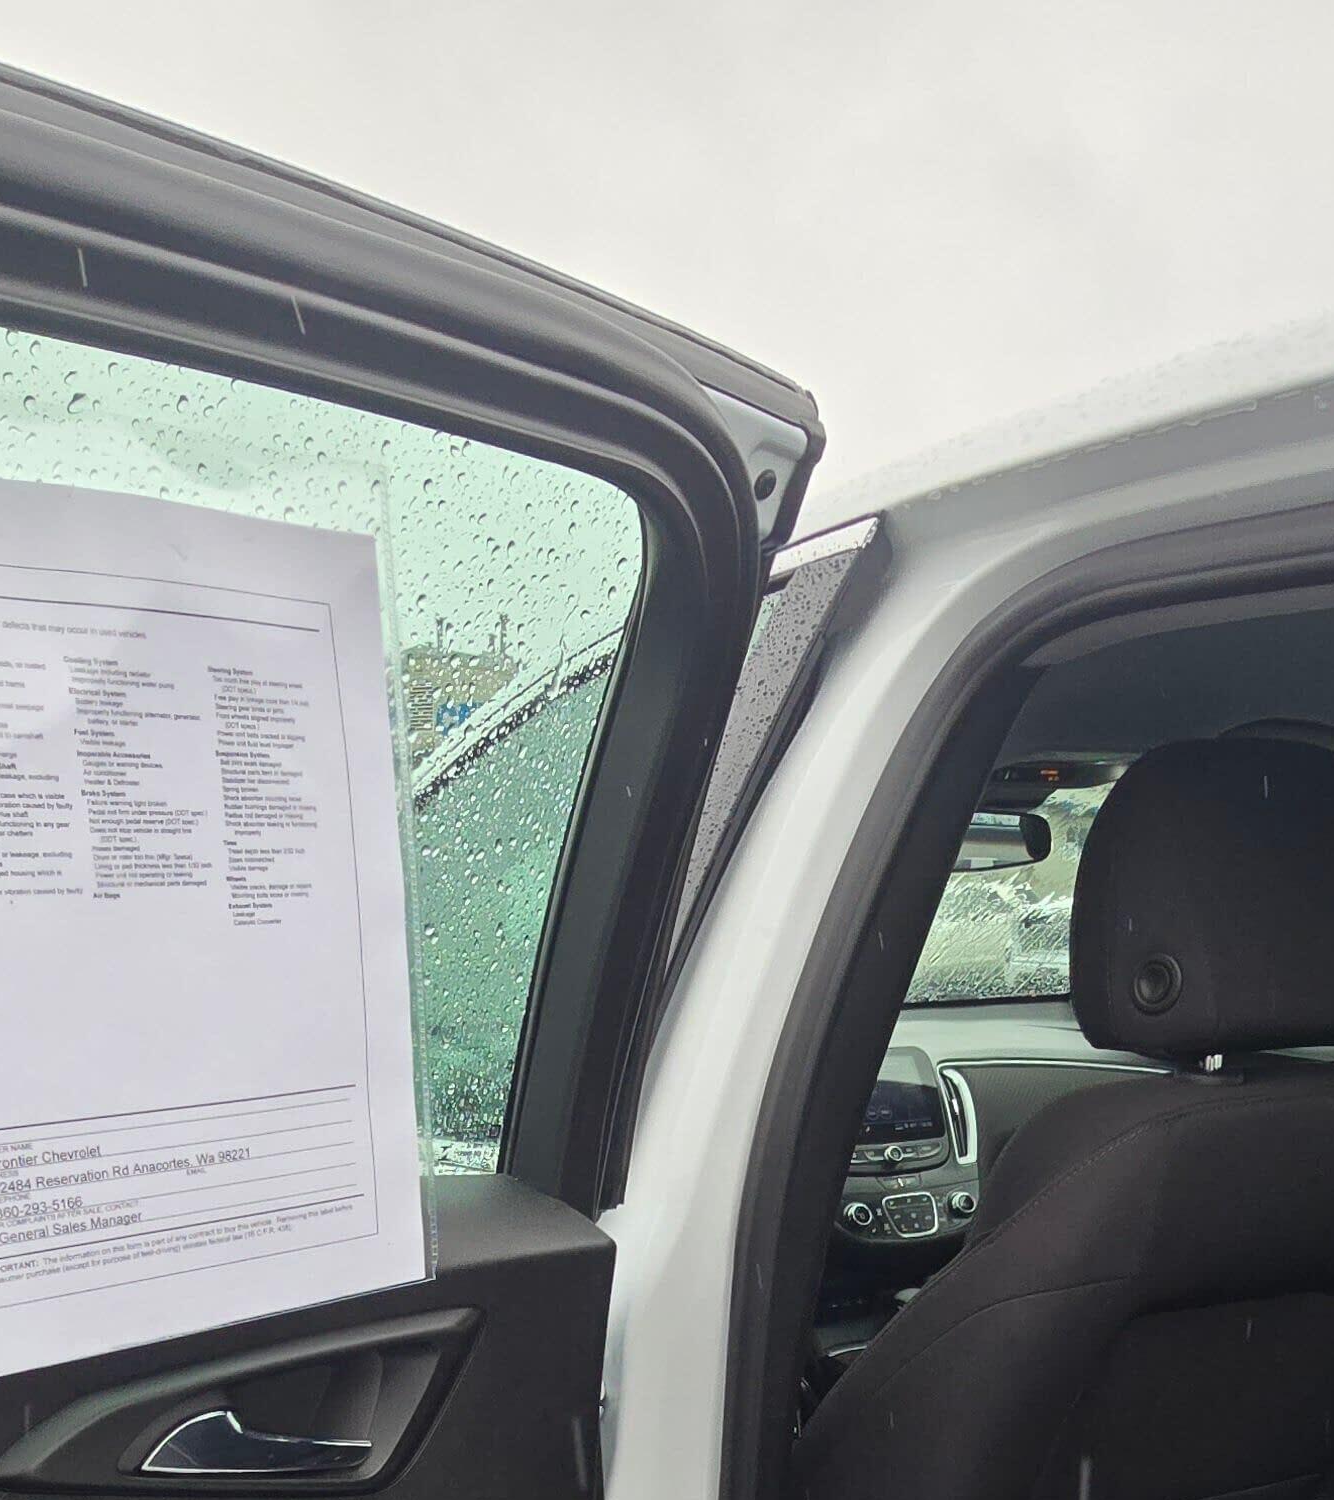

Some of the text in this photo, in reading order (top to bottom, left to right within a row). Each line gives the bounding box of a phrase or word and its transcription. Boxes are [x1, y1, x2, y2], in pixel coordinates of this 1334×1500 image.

[10, 1143, 33, 1151] NAME
[42, 1146, 101, 1163] Chevrolet
[36, 1168, 108, 1188] Reservation
[112, 1165, 129, 1177] Rd
[196, 1153, 215, 1166] Wa
[0, 1211, 143, 1243] General Sales Manager
[60, 1248, 100, 1262] information
[189, 1228, 214, 1239] contract
[27, 1265, 61, 1280] purchase
[103, 1255, 131, 1266] purpose
